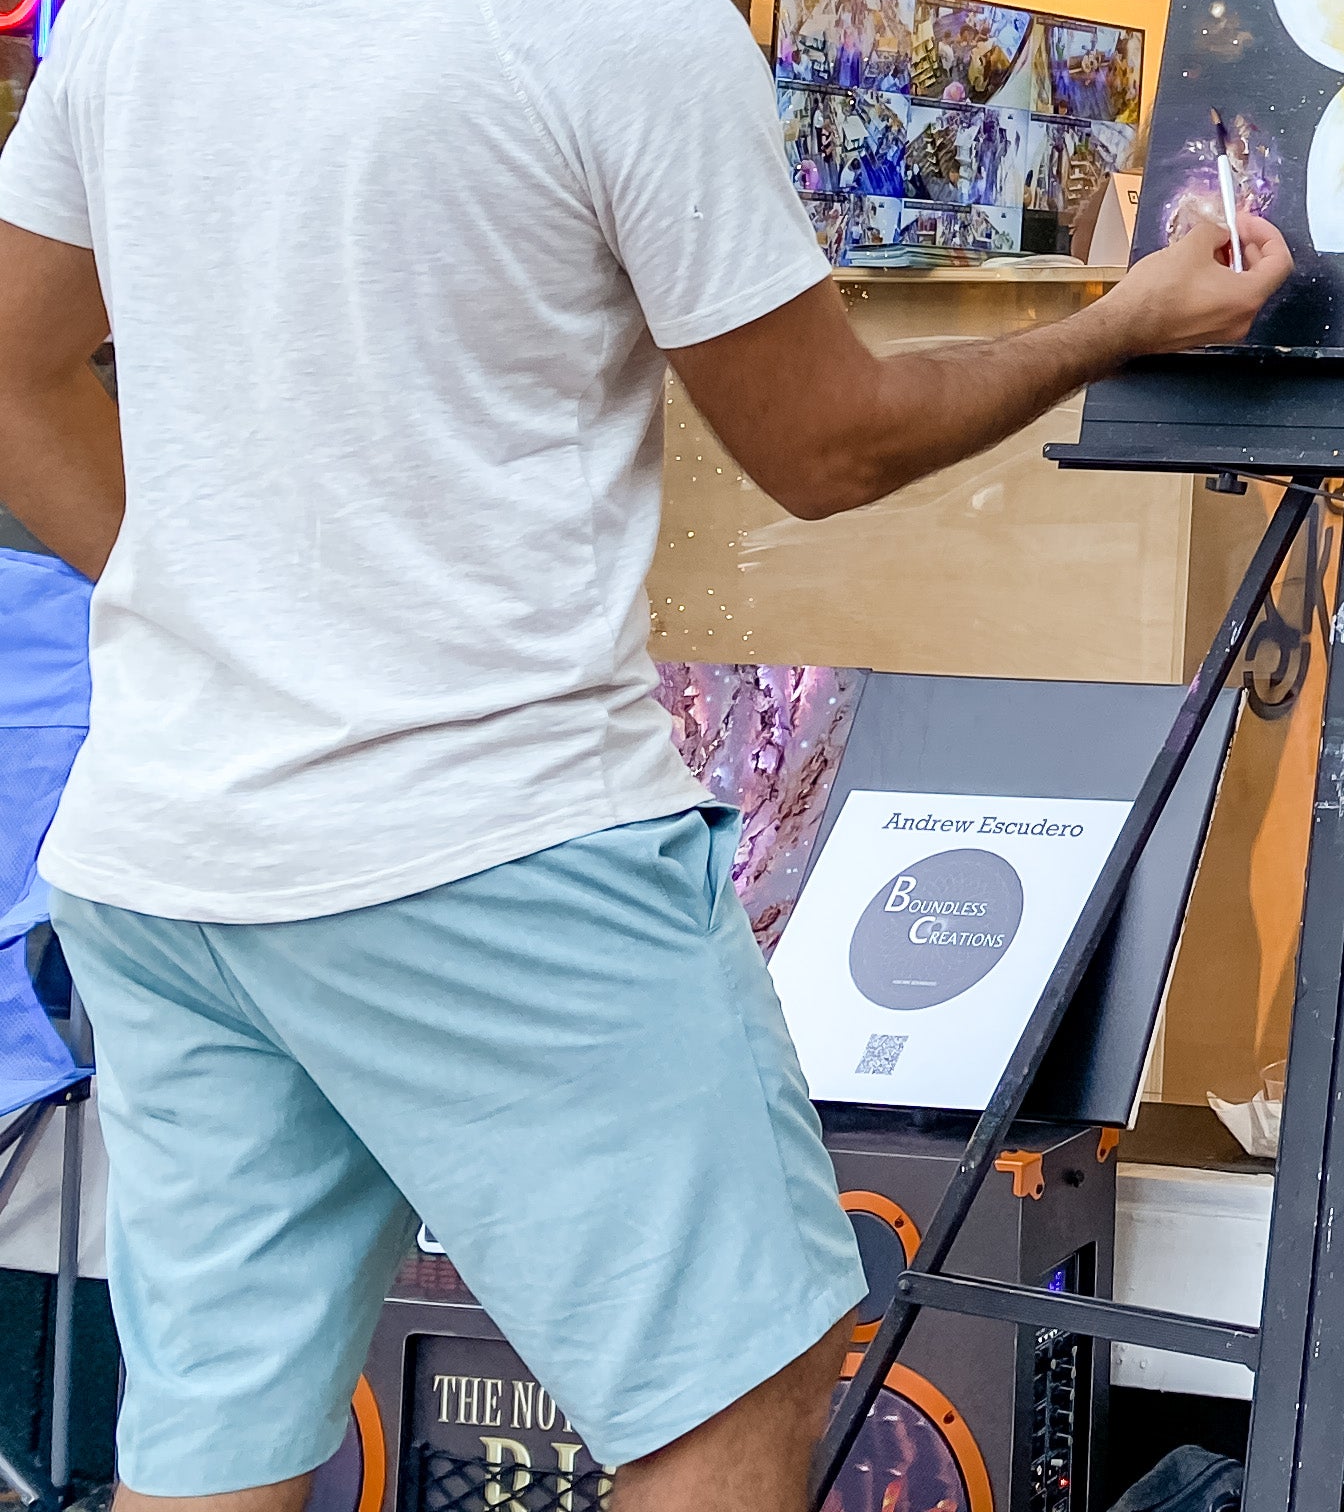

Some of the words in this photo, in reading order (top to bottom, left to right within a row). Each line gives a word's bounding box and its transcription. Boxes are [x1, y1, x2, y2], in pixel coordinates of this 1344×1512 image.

[882, 812, 974, 833] Andrew
[976, 816, 1085, 838] Escudero
[884, 874, 989, 918] BOUNDLESS
[907, 915, 1006, 949] CREATIONS
[433, 1374, 503, 1427] THE
